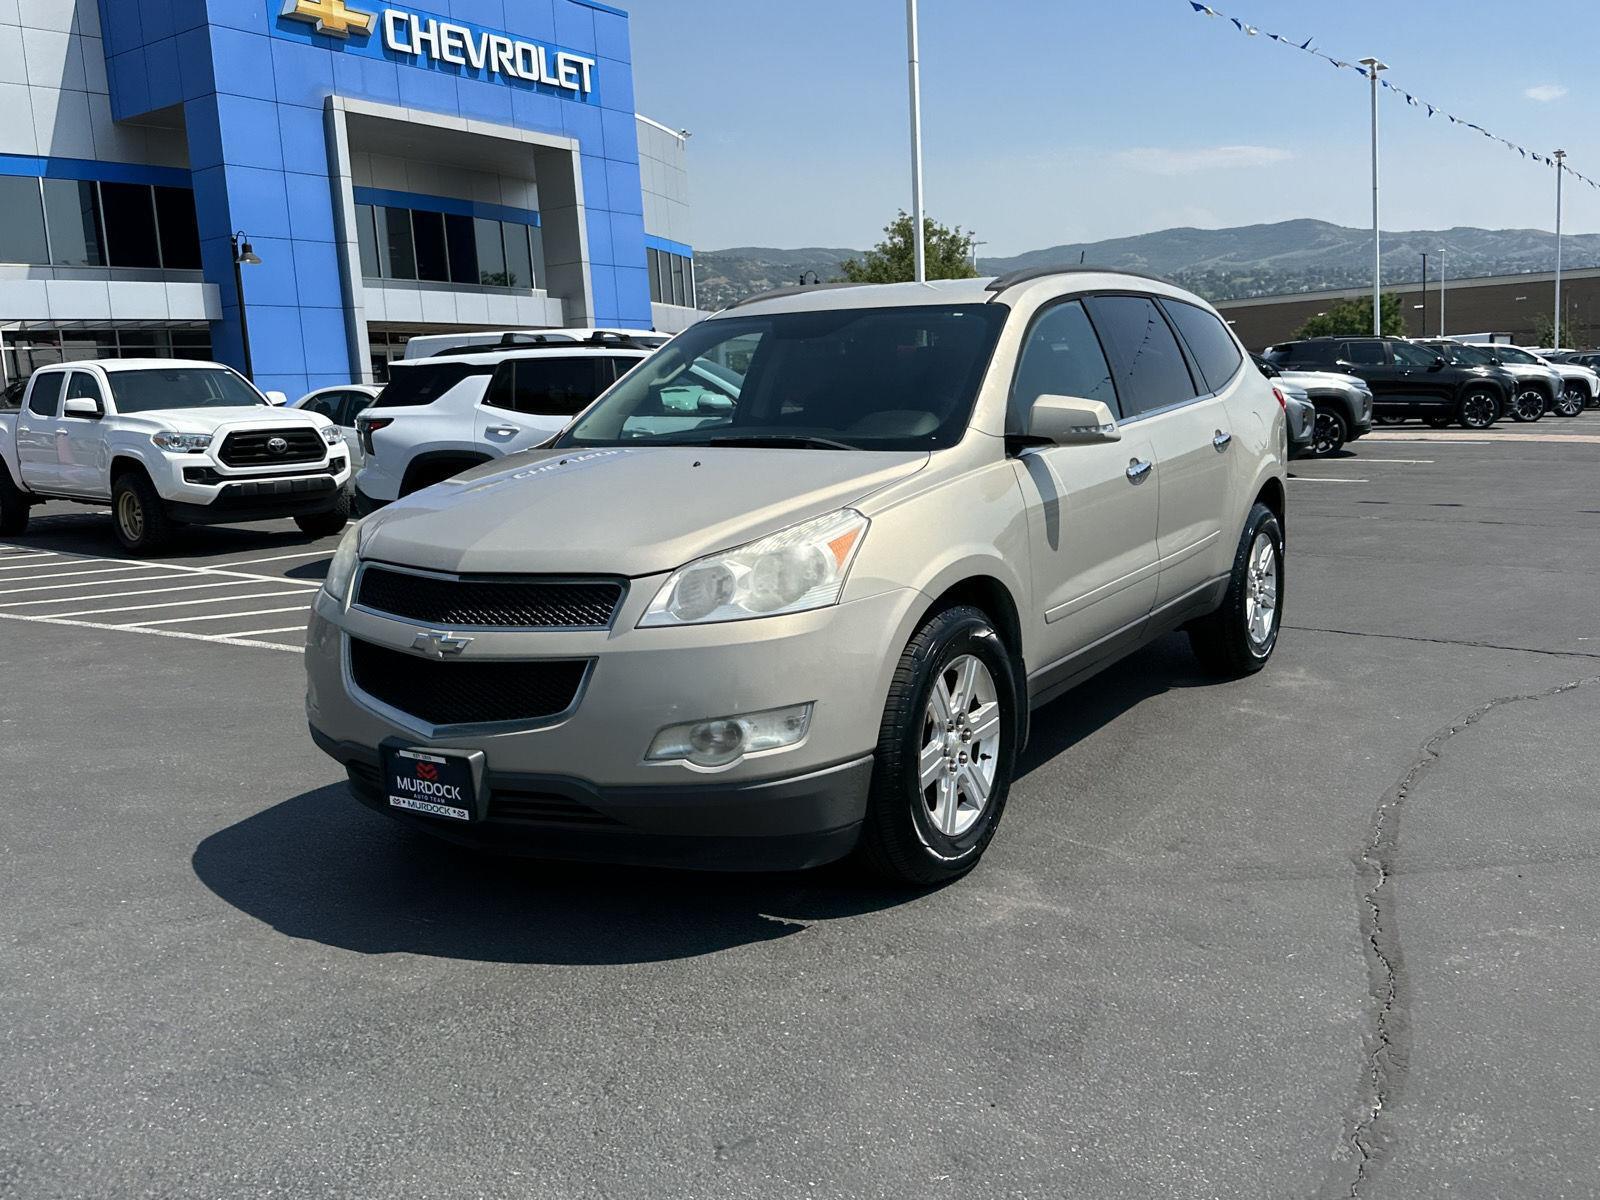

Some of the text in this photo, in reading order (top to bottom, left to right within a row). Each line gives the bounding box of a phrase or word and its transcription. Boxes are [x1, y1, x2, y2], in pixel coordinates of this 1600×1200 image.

[383, 9, 595, 93] CHEVROLET
[396, 775, 461, 800] MURDOCK
[407, 800, 451, 815] MURDOCK
[413, 793, 445, 804] AUTO TEAM
